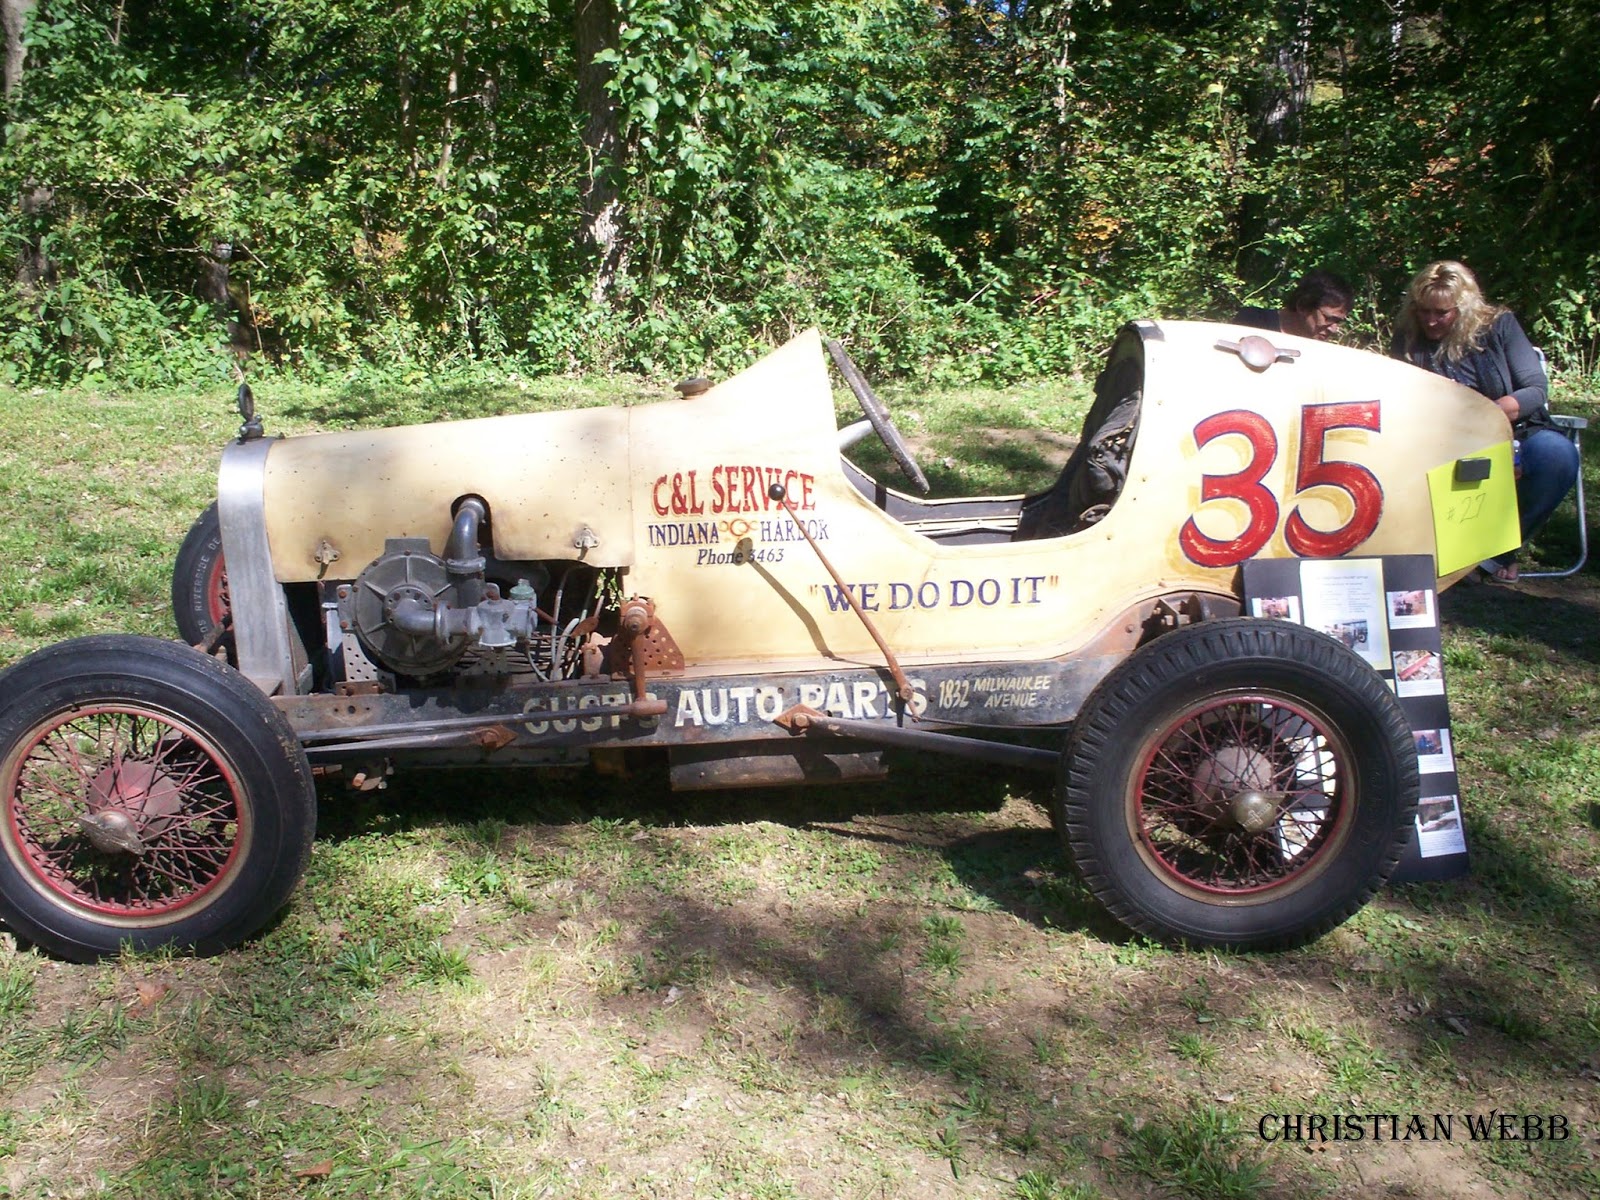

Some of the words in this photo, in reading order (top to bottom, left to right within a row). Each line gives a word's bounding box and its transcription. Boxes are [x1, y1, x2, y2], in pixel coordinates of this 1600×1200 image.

[653, 470, 705, 517] C&L
[711, 464, 816, 514] SERVICE
[1179, 400, 1384, 568] 35
[648, 521, 720, 547] INDIANA
[697, 548, 744, 565] Phone
[888, 581, 941, 610] DO
[950, 578, 1001, 607] DO
[674, 686, 784, 727] AUTO
[800, 679, 928, 719] PARTS
[939, 679, 970, 709] 1832
[973, 675, 1051, 692] MILWAUKEE
[984, 692, 1038, 708] AVENUE
